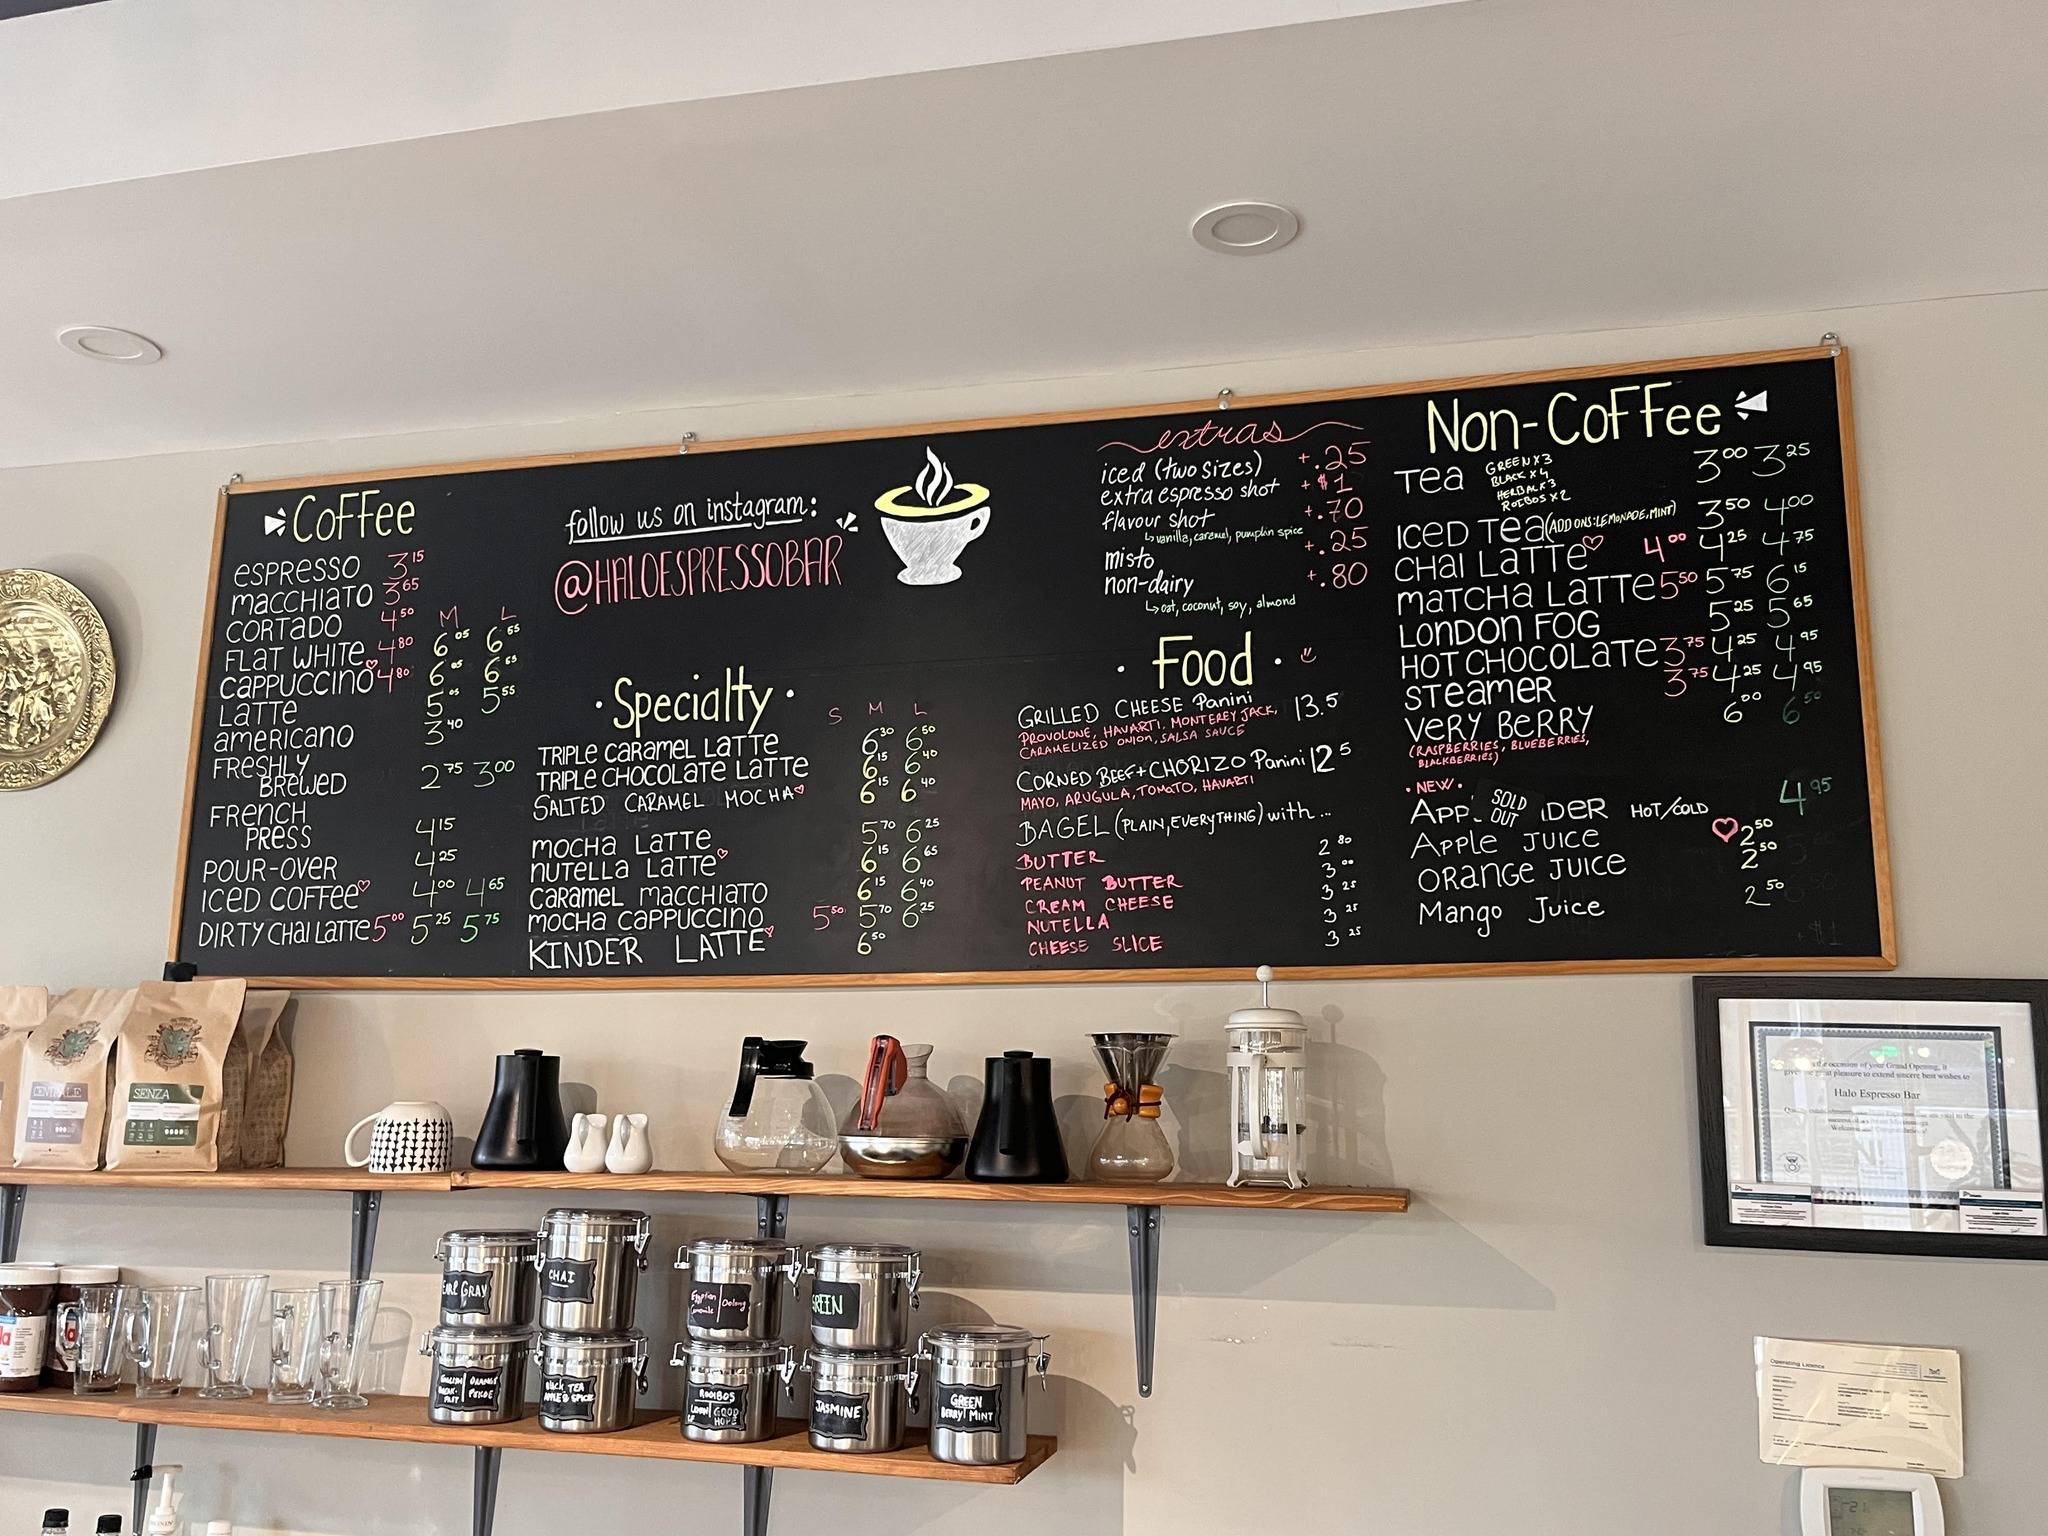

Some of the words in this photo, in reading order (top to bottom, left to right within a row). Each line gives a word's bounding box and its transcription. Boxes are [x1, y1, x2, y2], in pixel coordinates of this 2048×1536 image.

[1157, 420, 1283, 450] extras
[1101, 462, 1146, 485] iced
[1154, 456, 1197, 481] (two
[1201, 449, 1263, 480] sizes)
[1100, 488, 1153, 507] extra
[1158, 485, 1234, 508] espresso
[1239, 477, 1281, 499] shot
[565, 506, 624, 545] follow
[637, 506, 663, 529] us
[673, 502, 696, 527] on
[1102, 510, 1160, 532] flavour
[1169, 507, 1216, 530] shot
[1105, 546, 1154, 571] misto
[1105, 569, 1194, 597] non-dairy
[1256, 593, 1296, 609] almond
[1401, 651, 1459, 679] HOT
[613, 665, 774, 738] Specialty
[1115, 697, 1183, 719] CHEESE
[1192, 691, 1253, 712] Panini
[1171, 711, 1236, 729] MONTEREY
[1204, 724, 1246, 738] SAUCE
[1016, 770, 1092, 793] CORNED
[1251, 748, 1306, 771] Panini
[1202, 774, 1254, 792] HAVARTI
[533, 794, 606, 821] SALTED
[624, 792, 705, 813] CARAMEL
[725, 785, 795, 808] MOCHA
[1491, 789, 1527, 811] SOLD
[1490, 807, 1519, 828] OUT
[1015, 814, 1110, 847] BAGEL
[1015, 851, 1106, 871] BUTTER
[1021, 876, 1087, 893] PEANUT
[1101, 875, 1185, 890] BUTTER
[1025, 899, 1086, 915] CREAM
[1105, 896, 1174, 911] CHEESE
[1419, 901, 1503, 938] Mango
[1528, 896, 1606, 924] Juice
[1027, 913, 1110, 935] NUTELLA
[529, 936, 643, 971] KINDER
[675, 928, 766, 964] LATTE
[1029, 939, 1089, 957] CHEESE
[1113, 934, 1164, 953] SLICE
[132, 1088, 170, 1101] SENZA
[1834, 1088, 1857, 1098] Halo
[1860, 1089, 1901, 1101] Espresso
[1903, 1090, 1921, 1100] Bar
[548, 1269, 576, 1284] CHAI
[815, 1400, 862, 1419] JASMINE
[950, 1393, 983, 1408] GREEN
